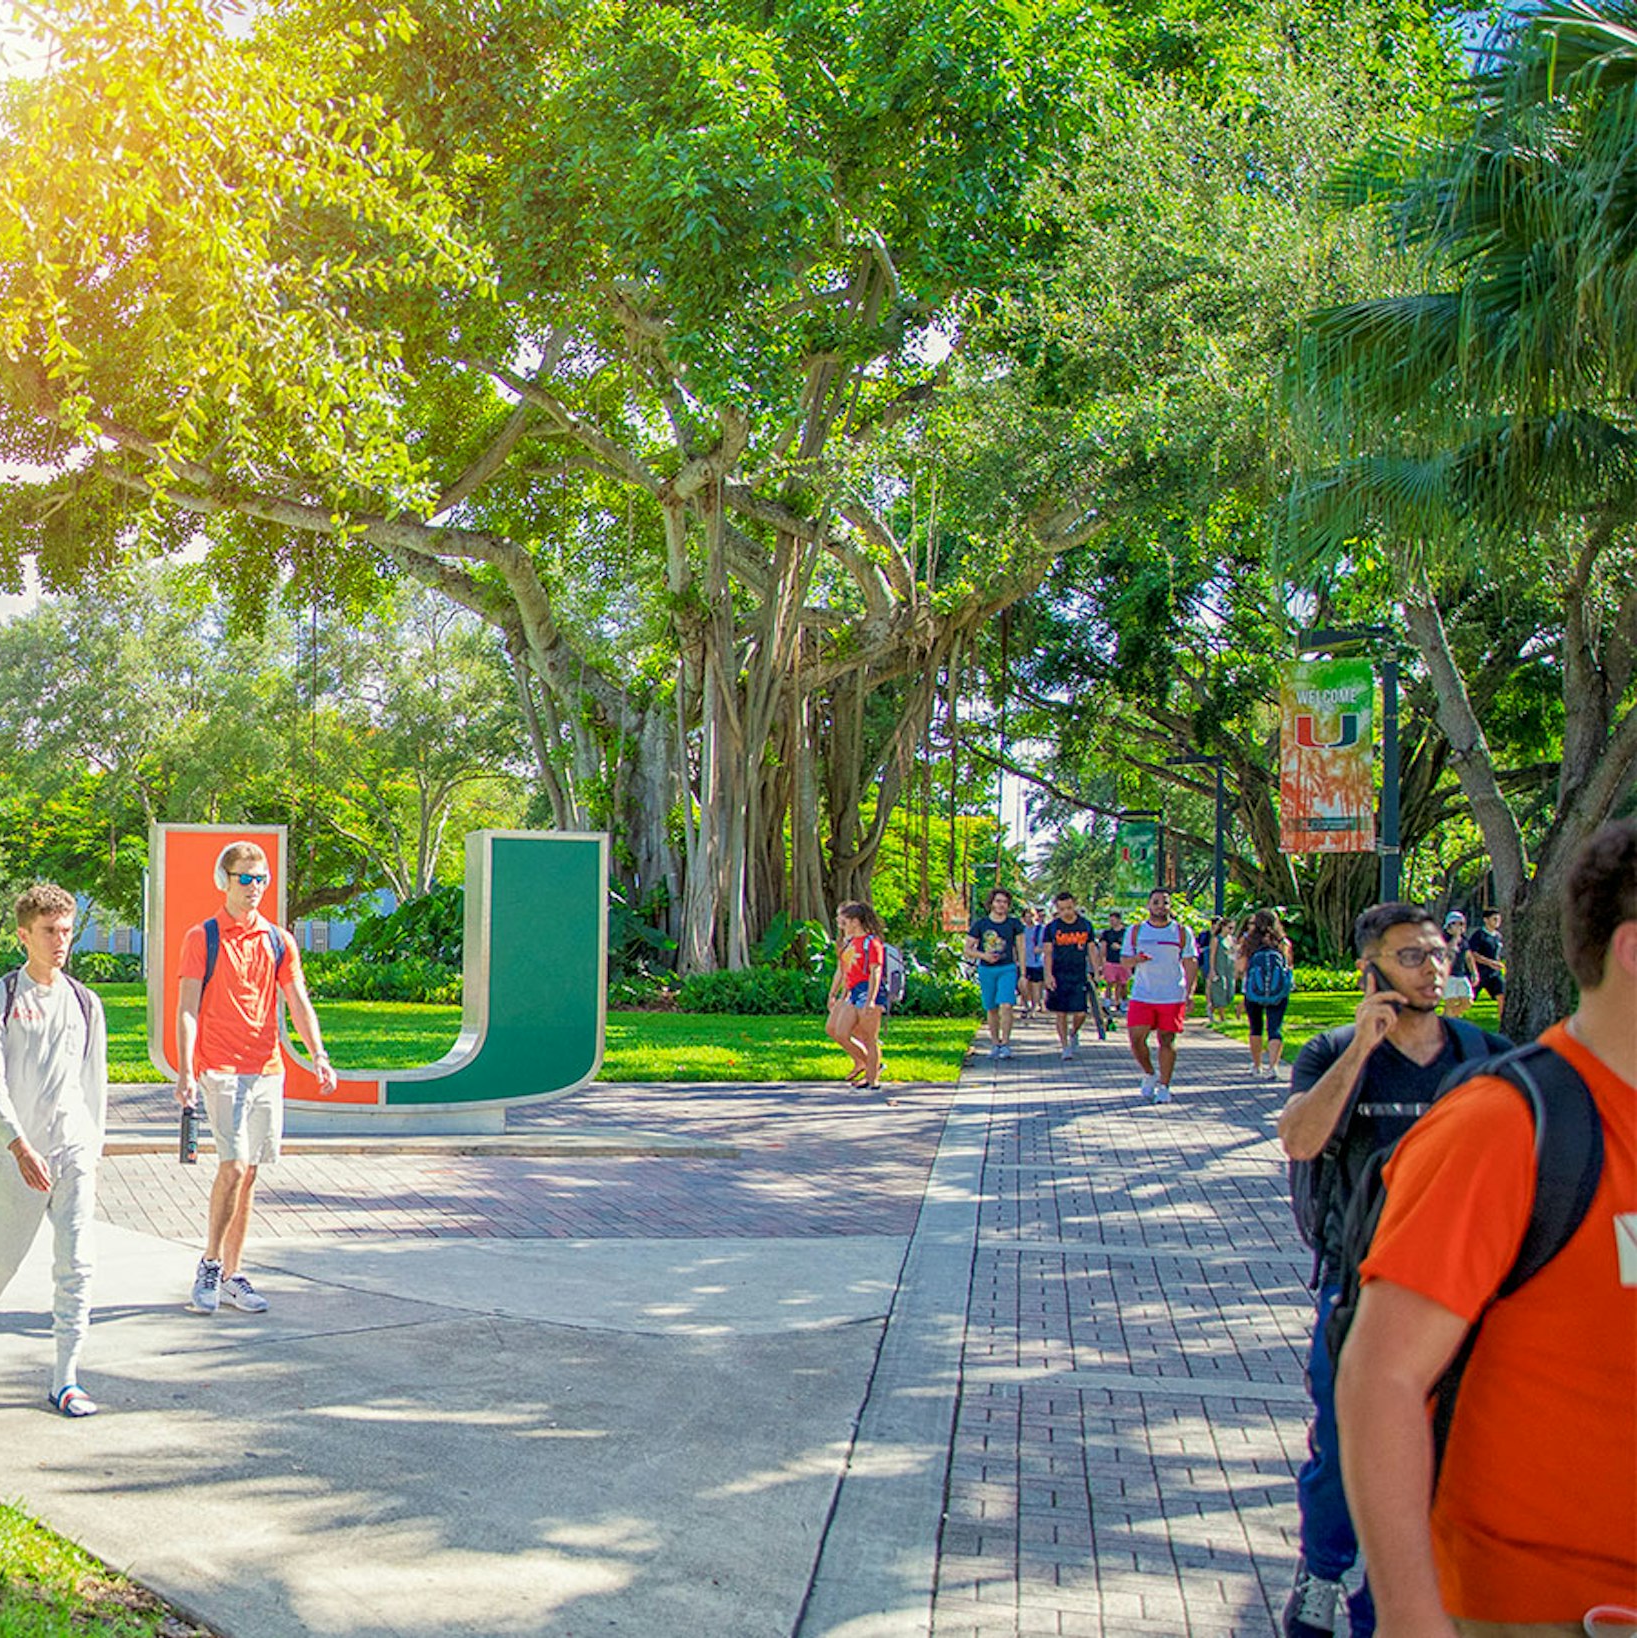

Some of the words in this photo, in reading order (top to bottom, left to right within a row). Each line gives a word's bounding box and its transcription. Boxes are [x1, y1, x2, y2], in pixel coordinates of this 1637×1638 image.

[1296, 688, 1357, 705] WELCOME
[1295, 713, 1359, 750] U
[147, 823, 609, 1112] U
